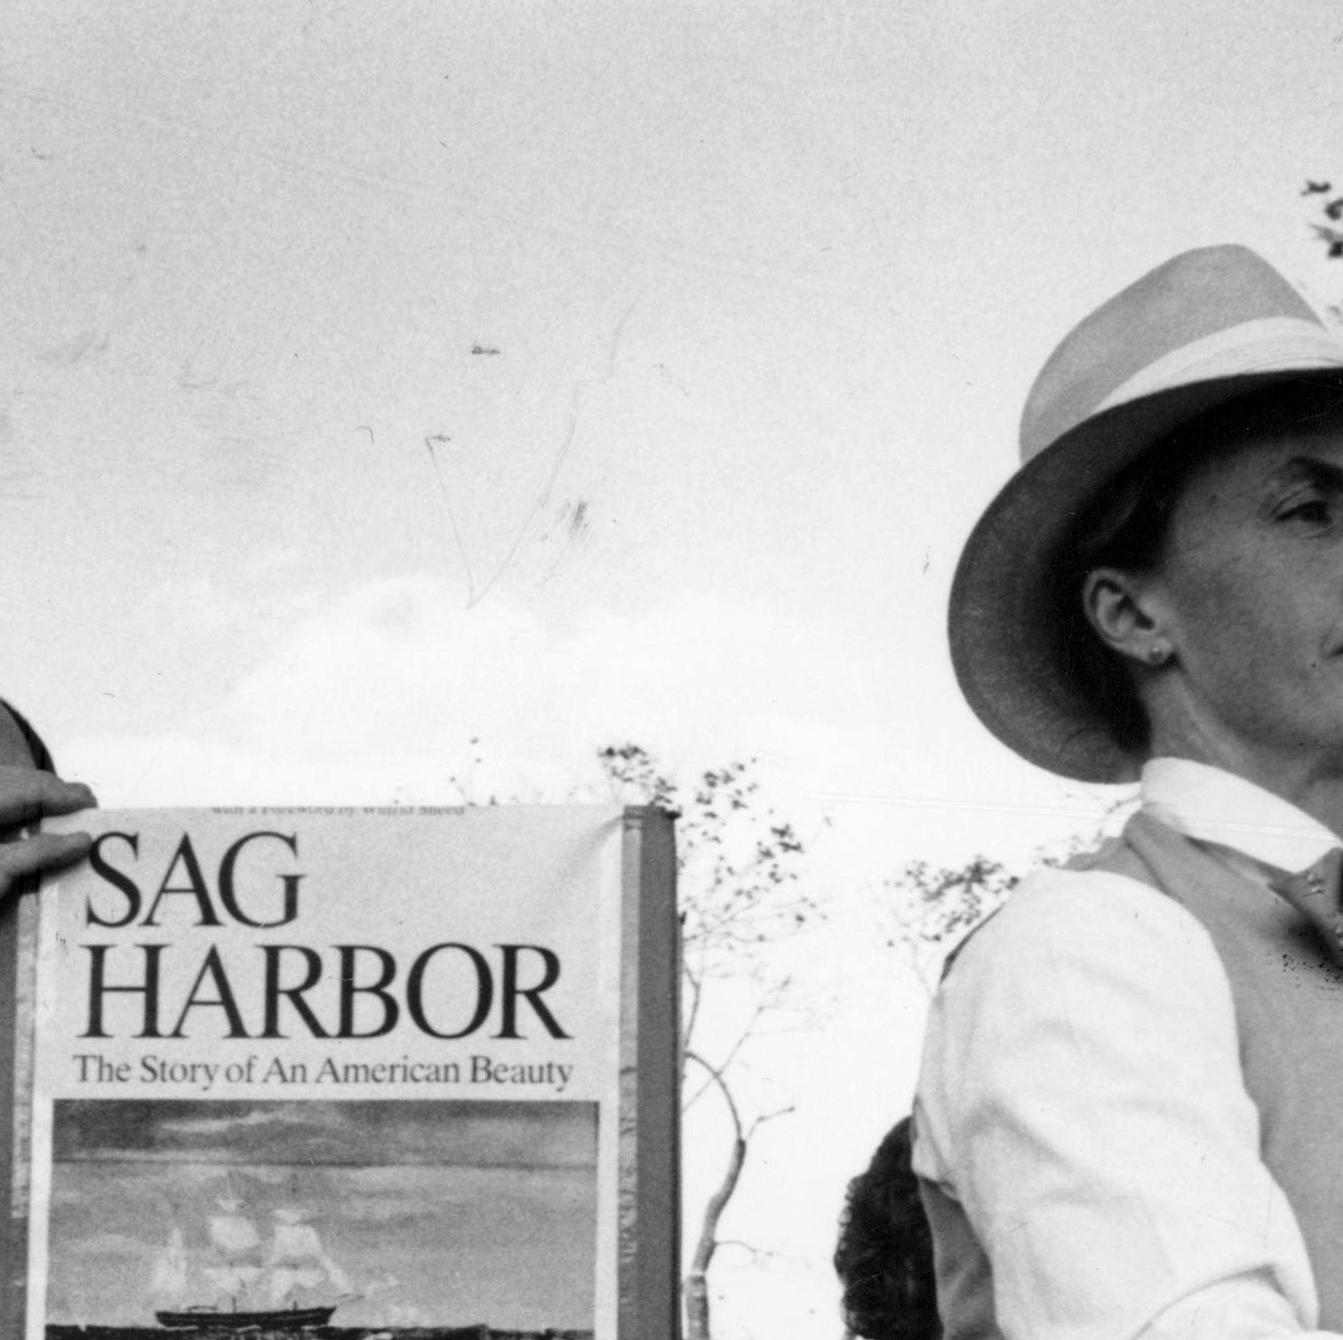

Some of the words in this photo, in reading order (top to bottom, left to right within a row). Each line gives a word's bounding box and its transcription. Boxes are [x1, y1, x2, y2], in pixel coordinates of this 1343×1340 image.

[86, 830, 307, 928] SAG
[76, 942, 575, 1040] HARBOR
[72, 1054, 132, 1084] The
[139, 1054, 221, 1092] Story
[224, 1054, 259, 1084] of
[261, 1055, 309, 1084] An
[314, 1054, 461, 1084] American
[469, 1054, 575, 1093] Beauty
